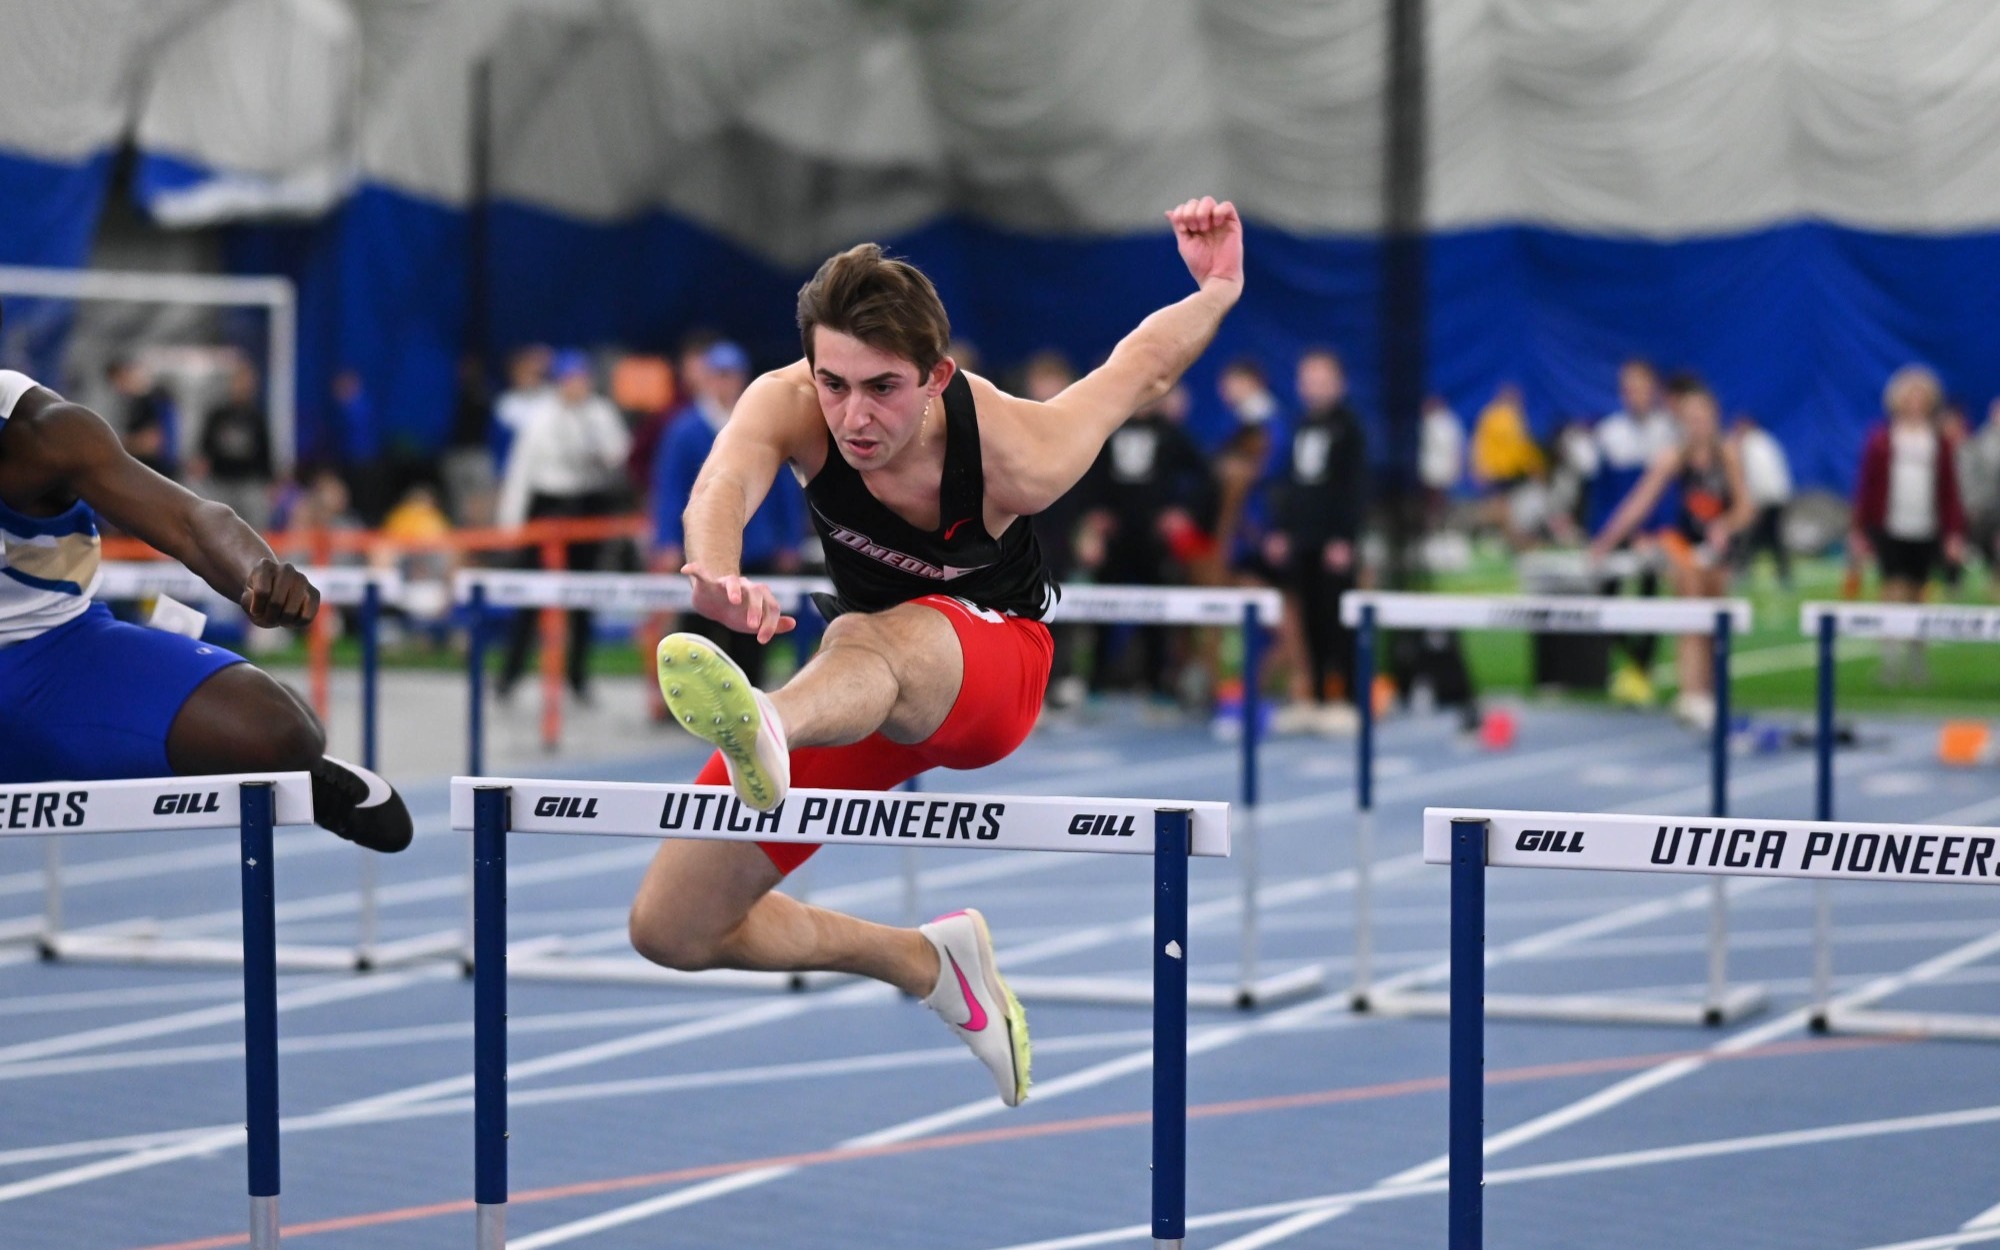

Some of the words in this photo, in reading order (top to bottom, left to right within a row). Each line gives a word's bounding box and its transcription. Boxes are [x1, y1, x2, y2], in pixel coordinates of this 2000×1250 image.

[829, 523, 946, 581] ONEON
[152, 791, 221, 816] GILL
[533, 796, 599, 819] GILL
[659, 792, 786, 834] UTICA
[797, 797, 1005, 841] PIONEERS
[1067, 813, 1136, 838] GILL
[1515, 829, 1585, 853] GILL
[1650, 826, 1788, 870] UTICA
[1800, 832, 2000, 877] PIONEER
